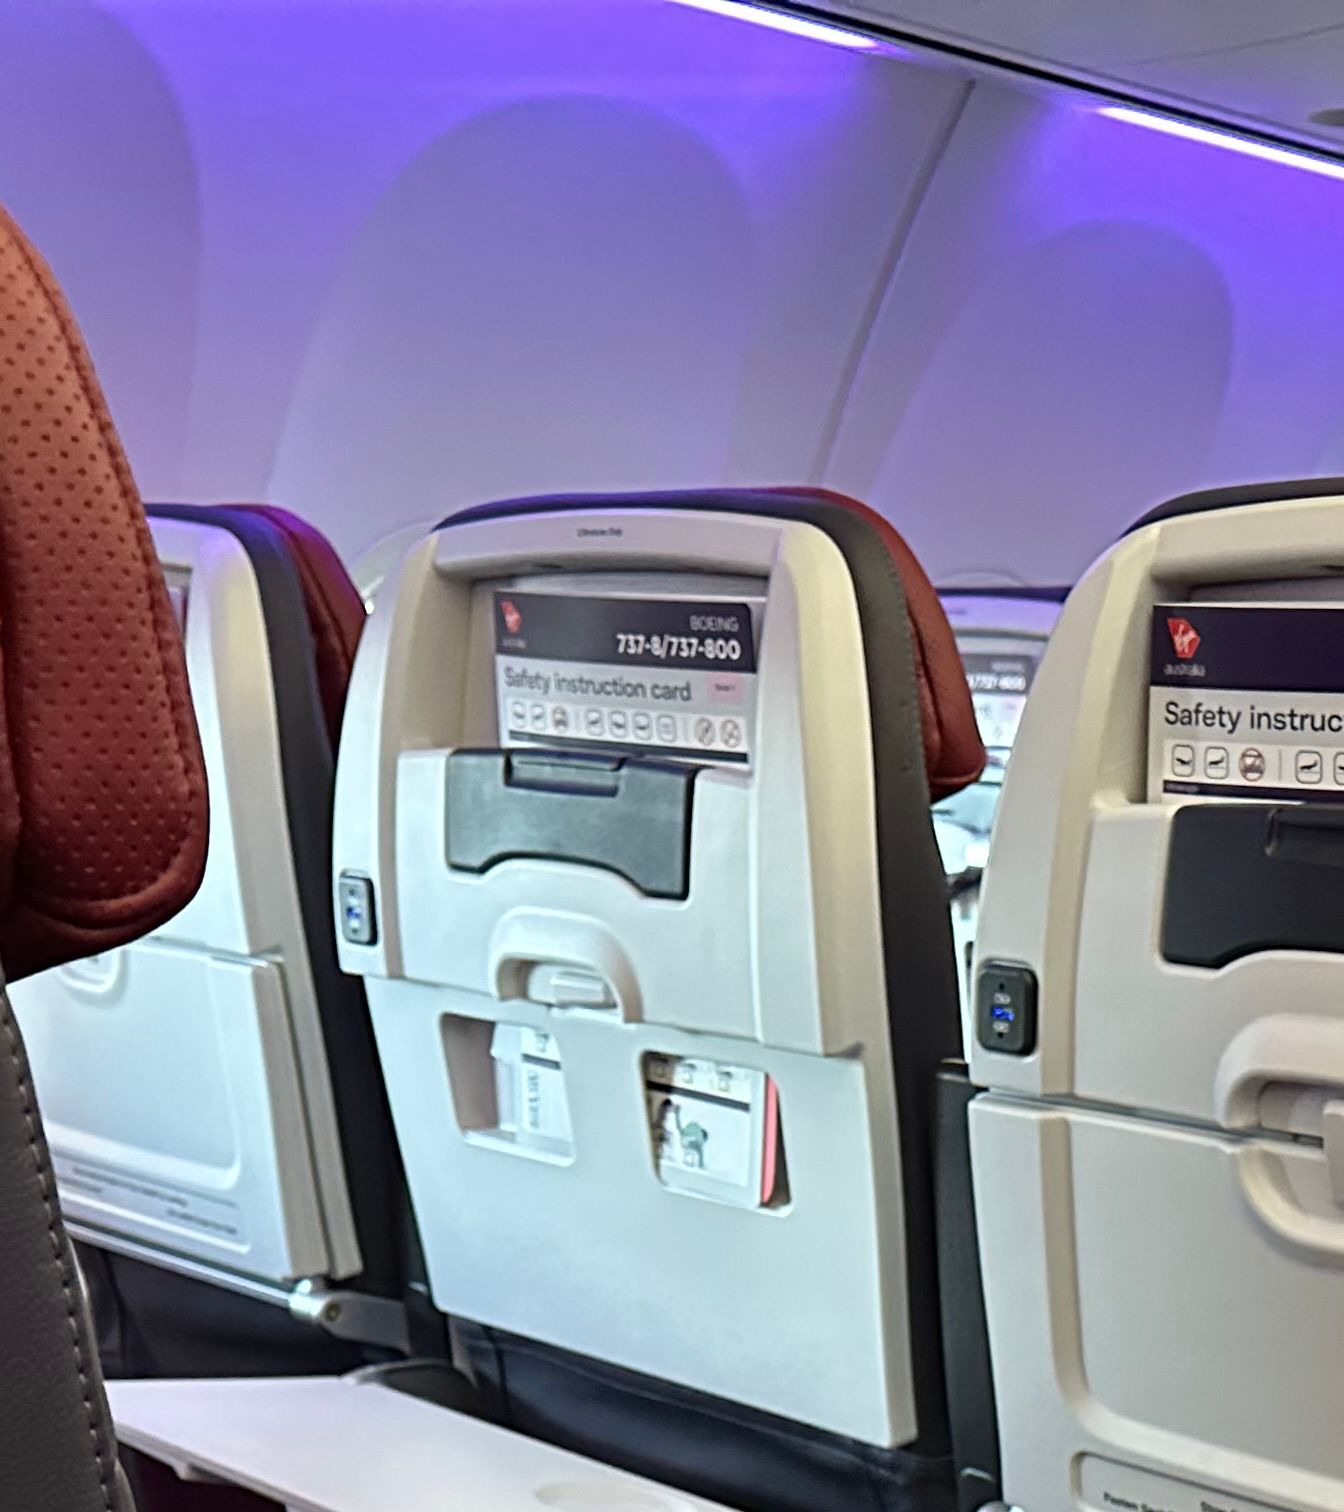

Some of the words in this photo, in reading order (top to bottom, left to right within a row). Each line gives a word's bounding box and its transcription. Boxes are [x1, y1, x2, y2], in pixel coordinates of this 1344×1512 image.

[689, 614, 739, 632] BOEING
[616, 633, 742, 661] 737-8/737-800
[503, 667, 551, 695] Safety
[554, 674, 647, 701] instruction
[650, 681, 692, 701] card
[1164, 701, 1242, 733] Safety
